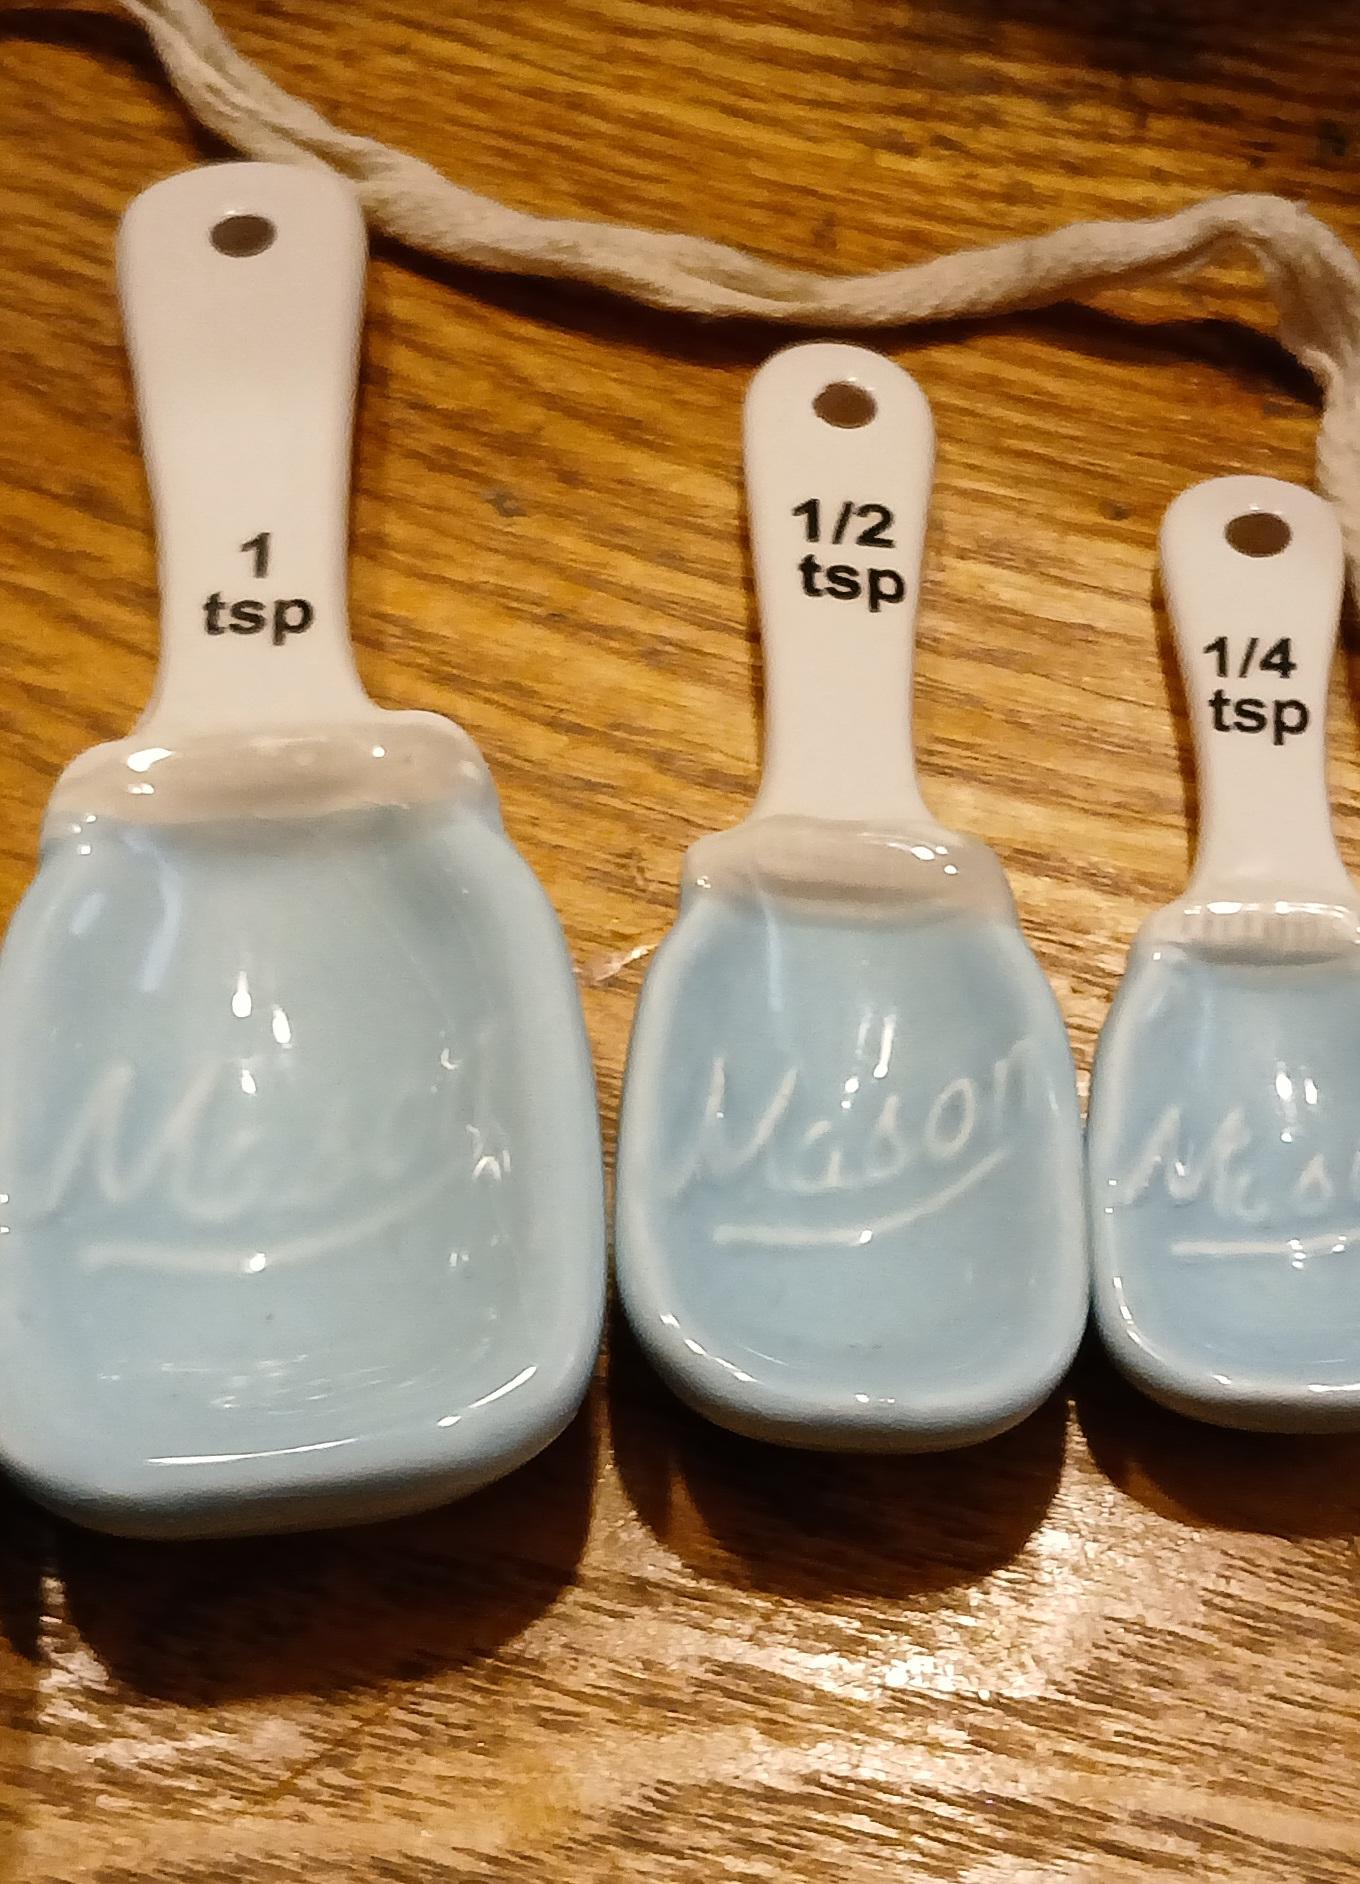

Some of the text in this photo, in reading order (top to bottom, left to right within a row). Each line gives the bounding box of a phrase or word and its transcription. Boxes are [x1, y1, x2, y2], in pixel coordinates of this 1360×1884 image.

[791, 497, 897, 549] 1/2
[239, 531, 272, 580] 1
[796, 552, 907, 614] tsp
[201, 591, 315, 648] tsp
[1202, 635, 1298, 680] 1/4
[1207, 688, 1311, 747] tsp
[655, 1035, 1040, 1198] Mason
